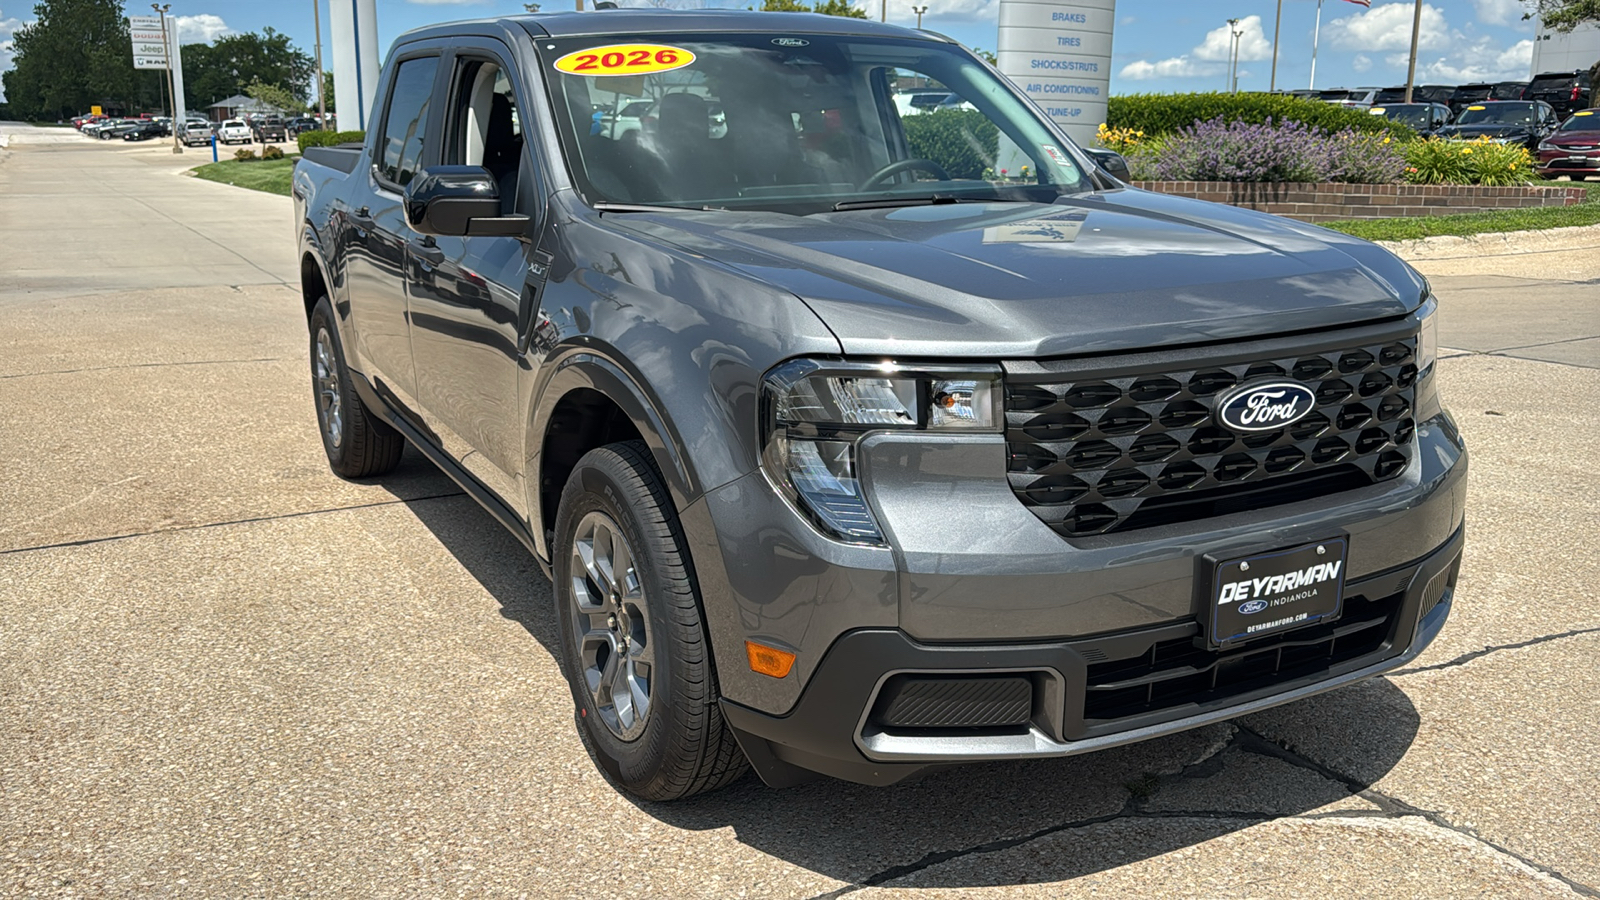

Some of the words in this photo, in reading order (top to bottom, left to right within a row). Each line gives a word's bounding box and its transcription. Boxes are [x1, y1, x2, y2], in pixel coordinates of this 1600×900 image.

[1052, 12, 1086, 23] BRAKES
[1057, 37, 1081, 47] TIRES
[140, 45, 163, 53] Jeep
[573, 50, 679, 71] 2026
[1031, 59, 1098, 72] SHOCKS/STRUTS
[1026, 83, 1042, 93] AIR
[1044, 84, 1099, 95] CONDITIONING
[1047, 107, 1082, 118] TUNE-UP
[528, 262, 546, 275] XLT
[1240, 390, 1299, 425] Ford
[1218, 560, 1341, 605] DEYARMAN
[1270, 588, 1318, 607] INDIANOLA
[1247, 612, 1308, 633] DEYARMANFORD.COM
